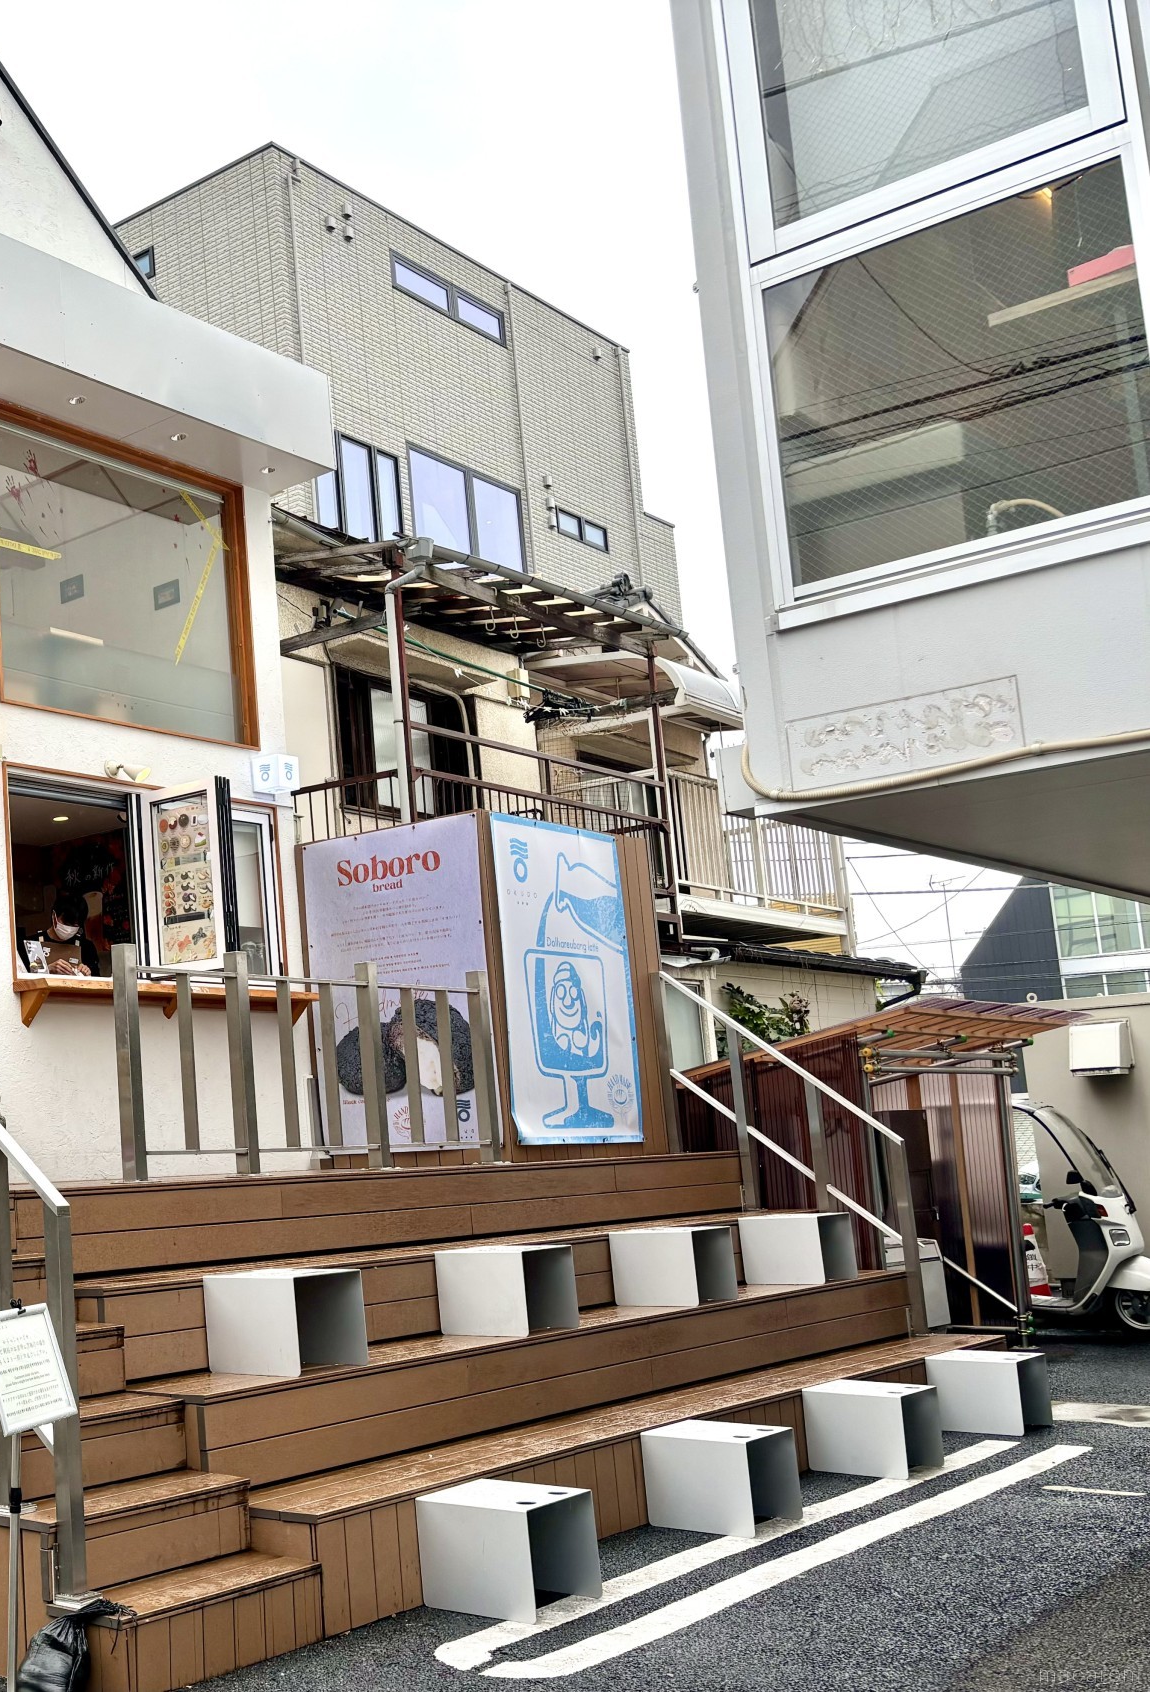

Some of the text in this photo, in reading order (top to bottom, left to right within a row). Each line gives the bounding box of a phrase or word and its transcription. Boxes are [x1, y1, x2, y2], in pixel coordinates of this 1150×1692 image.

[336, 850, 441, 887] Soboro
[372, 878, 403, 892] bread
[588, 940, 599, 952] latte
